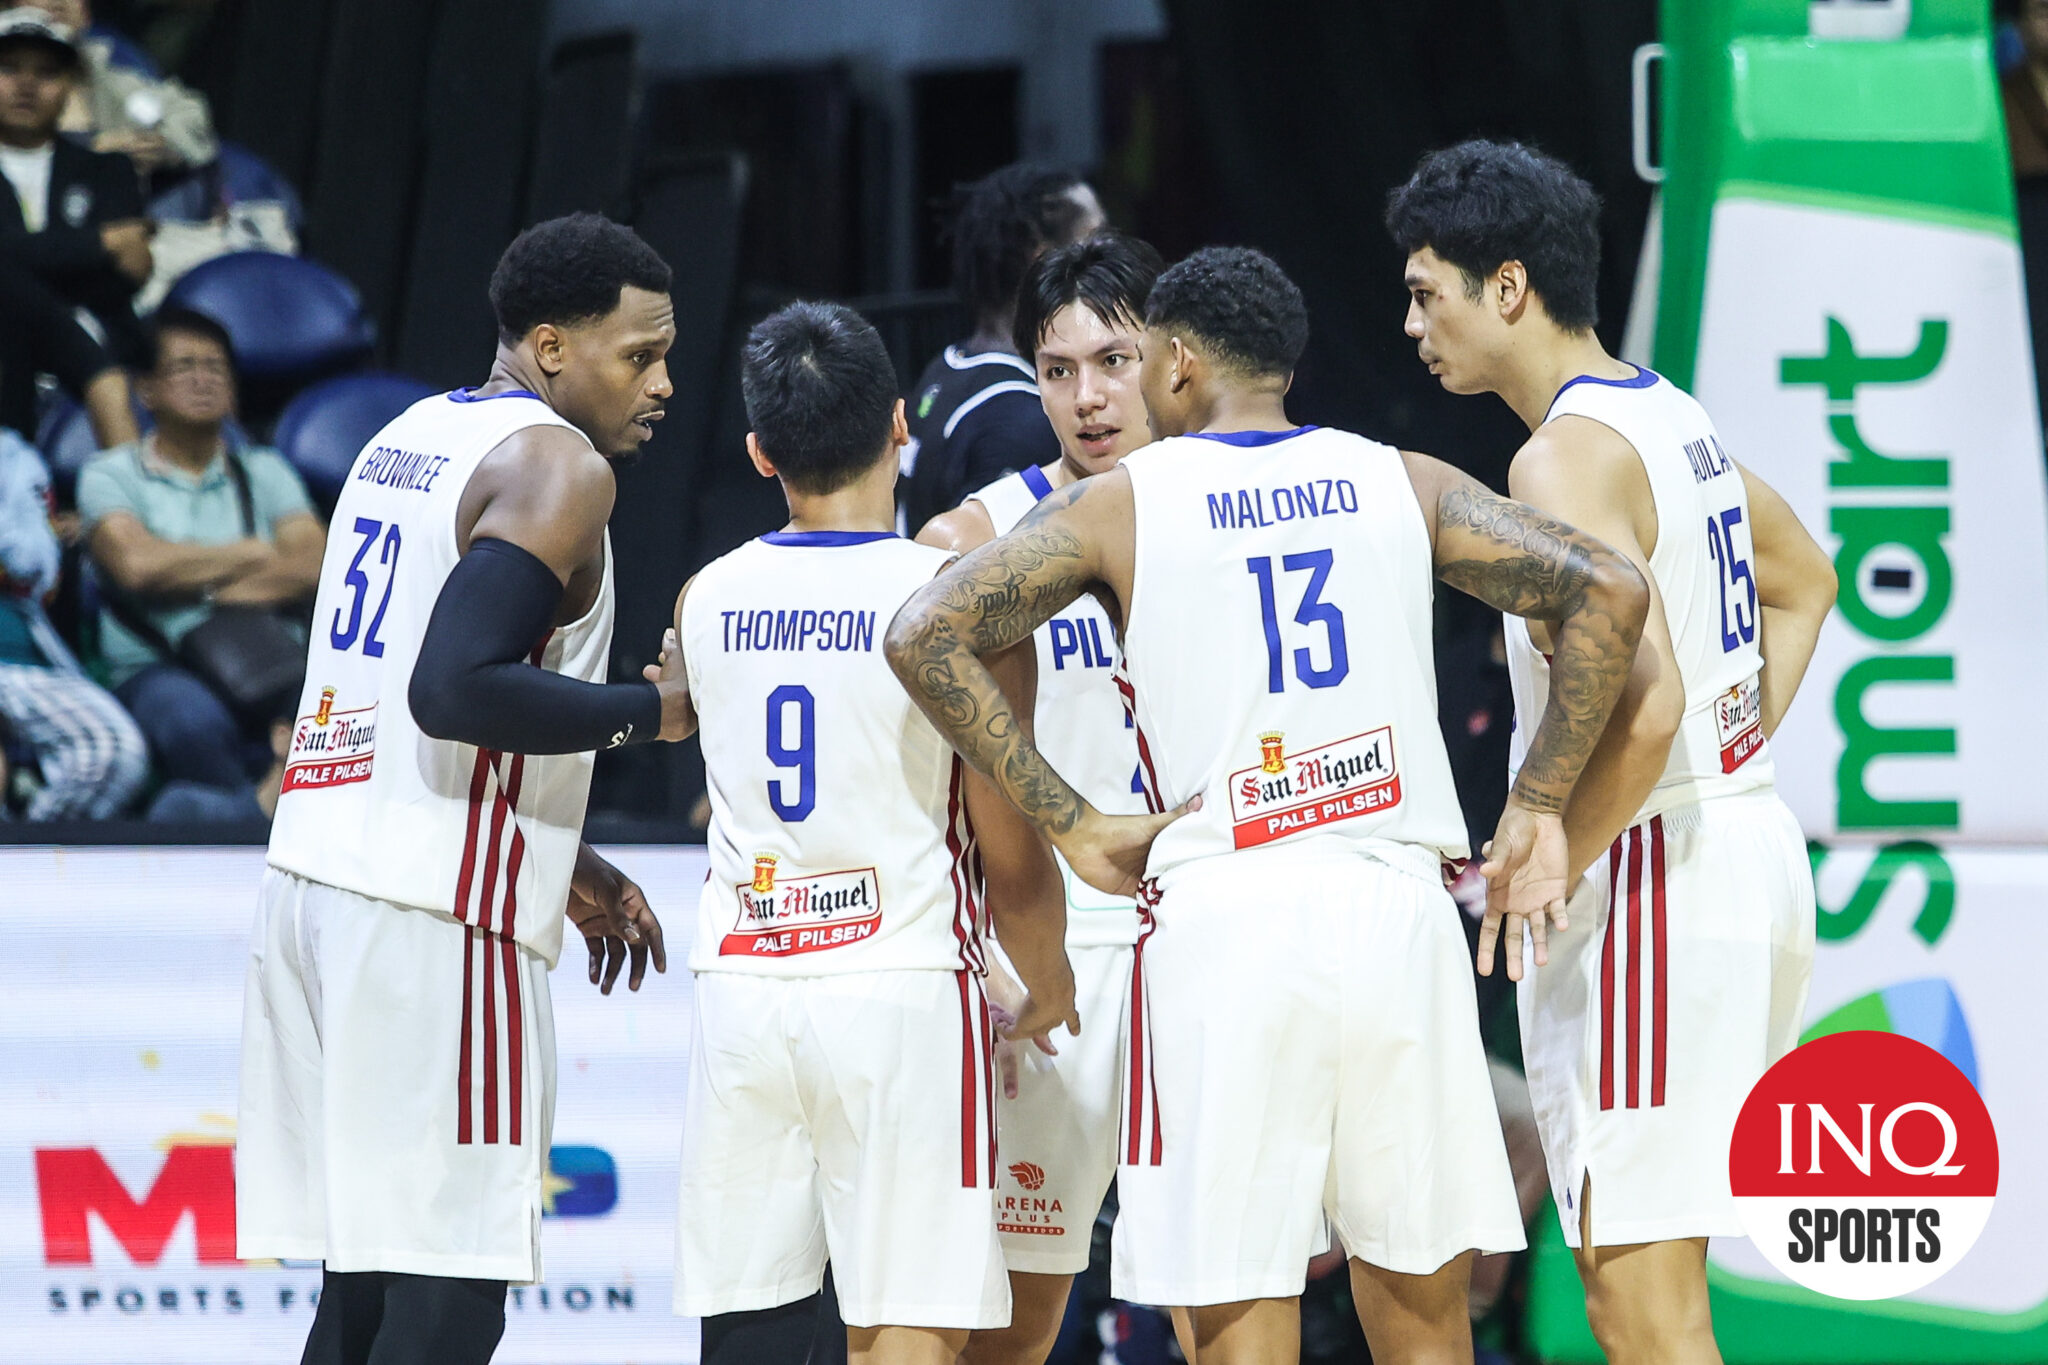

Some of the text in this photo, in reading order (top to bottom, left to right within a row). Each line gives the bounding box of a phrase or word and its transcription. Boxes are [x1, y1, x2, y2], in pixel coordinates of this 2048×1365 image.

[357, 446, 450, 493] BROWNLEE
[1206, 479, 1358, 529] MALONZO
[330, 516, 401, 658] 32
[1707, 506, 1756, 654] 25
[720, 610, 876, 652] THOMPSON
[1246, 548, 1350, 693] 13
[1780, 316, 1959, 947] smart
[293, 725, 327, 755] San
[766, 685, 816, 823] 9
[292, 766, 332, 785] PALE
[1240, 738, 1384, 809] San Miguel
[1266, 785, 1394, 835] PALE PILSEN
[743, 876, 869, 922] San Miguel
[751, 923, 872, 953] PALE PILSEN
[1001, 1212, 1050, 1224] PLUS
[49, 1288, 244, 1313] SPORTS
